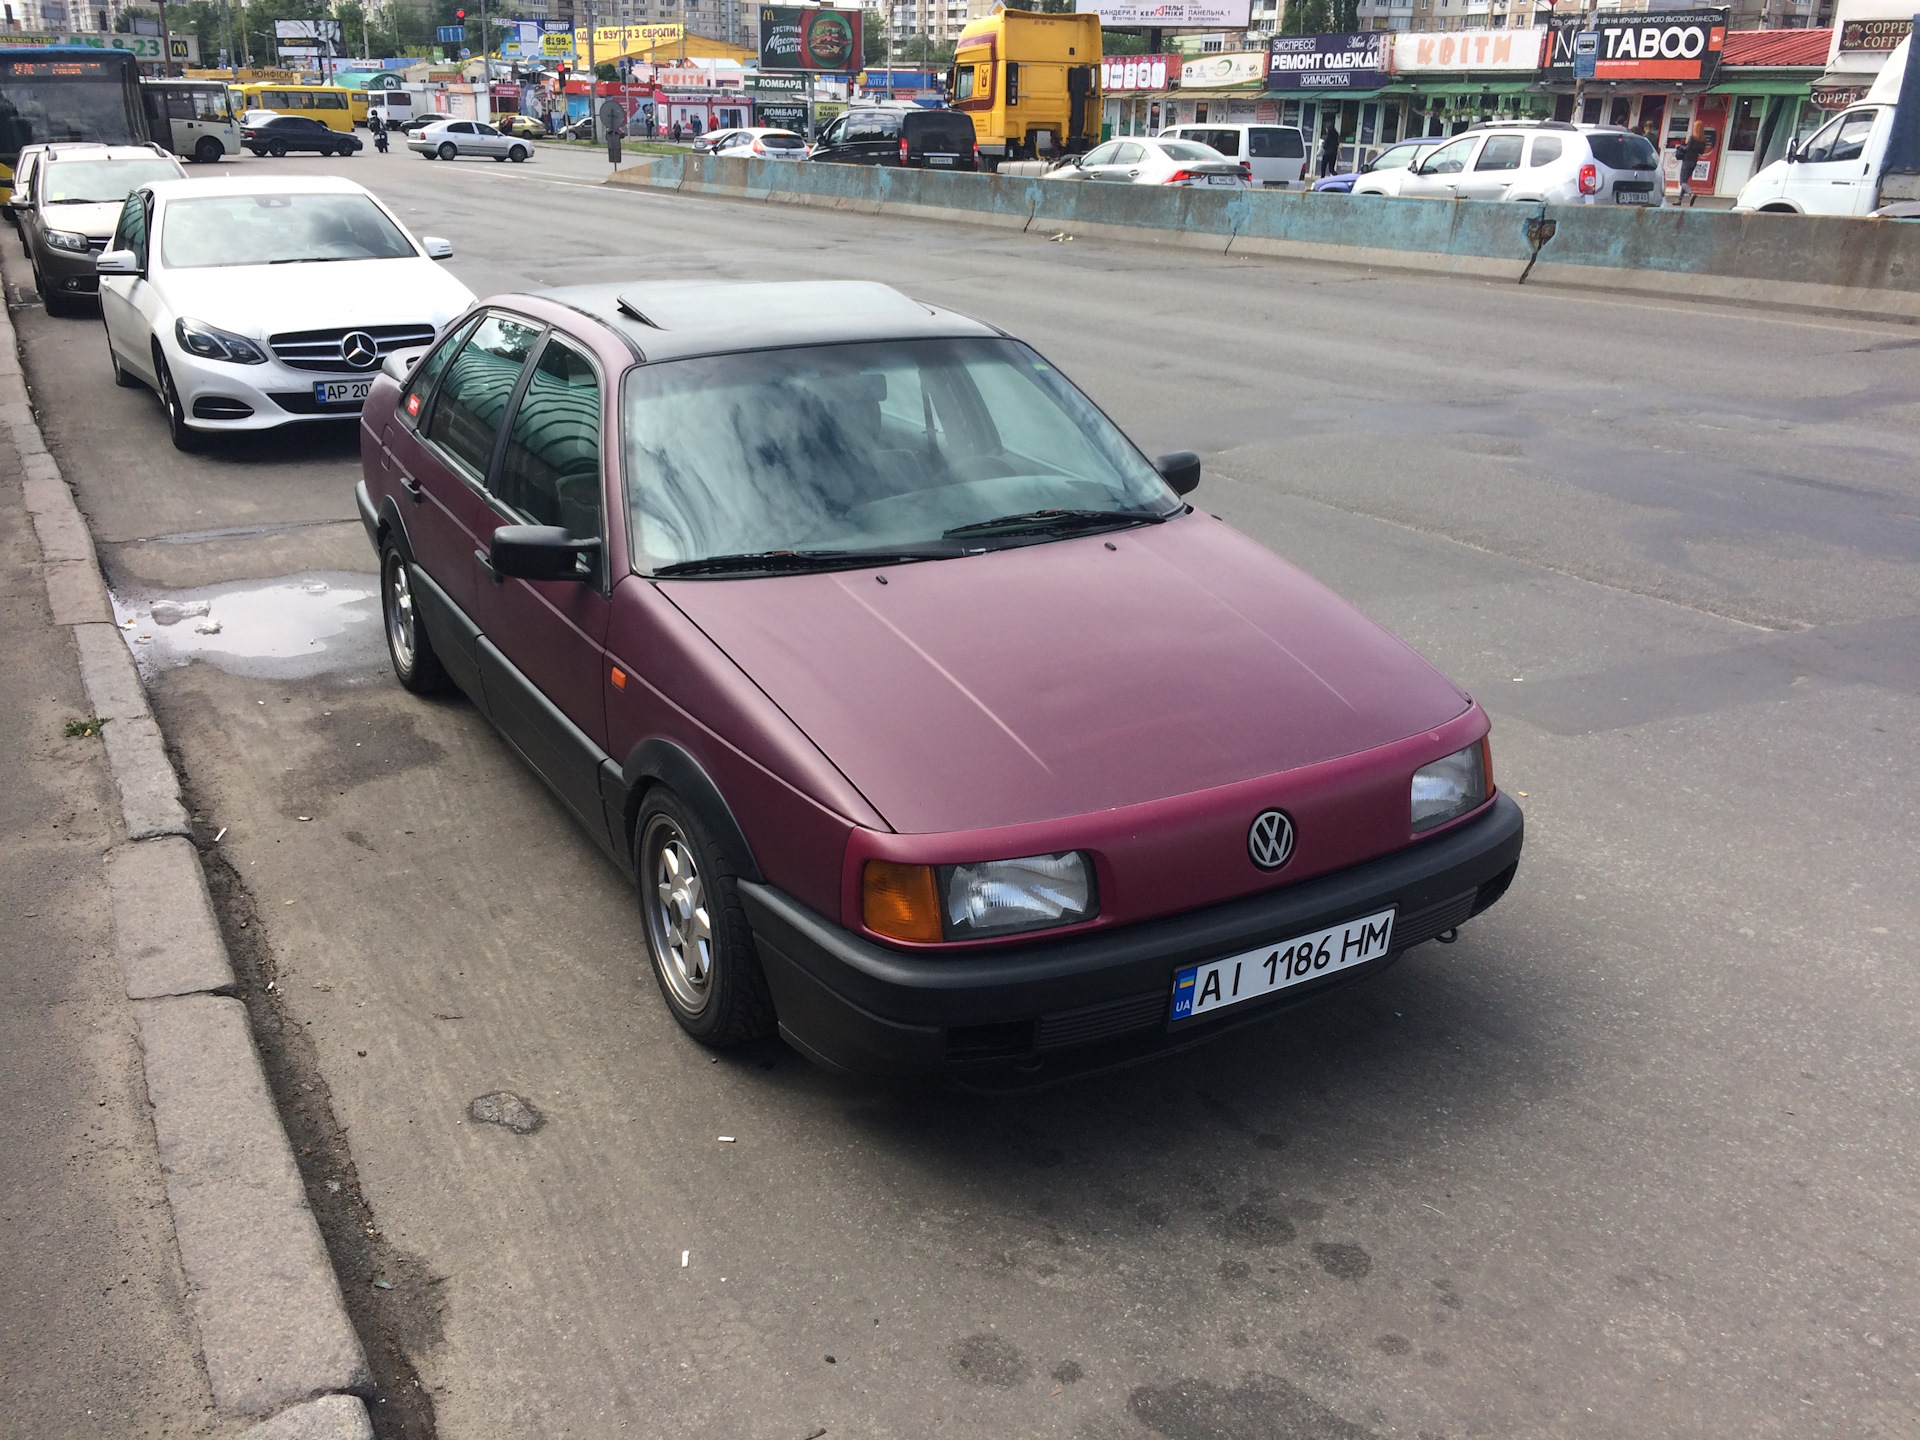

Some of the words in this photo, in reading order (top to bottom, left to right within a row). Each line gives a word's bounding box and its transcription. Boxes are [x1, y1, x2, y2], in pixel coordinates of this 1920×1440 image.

[603, 29, 632, 39] ВЗУТТЯ
[634, 29, 640, 39] З
[642, 27, 676, 38] ЄВРОПИ
[772, 25, 802, 34] ЗУСТРІЧАЙ
[1865, 22, 1914, 34] COPPER
[1274, 40, 1315, 51] ЭКСПРЕСС
[1603, 26, 1705, 59] TABOO
[1863, 36, 1904, 48] COFFE
[1417, 34, 1513, 66] КВІТИ
[1271, 53, 1323, 70] РЕМОНТ
[758, 79, 803, 89] ЛОМБАРД
[1301, 75, 1349, 85] ХИМЧИСТКА
[1810, 92, 1857, 104] COPPER
[763, 108, 803, 117] ЛОМБАРД
[327, 384, 348, 399] AP
[352, 383, 372, 398] 20
[1197, 961, 1242, 1007] AI
[1263, 935, 1332, 986] 1186
[1340, 917, 1390, 963] HM
[1176, 1001, 1191, 1012] UA
